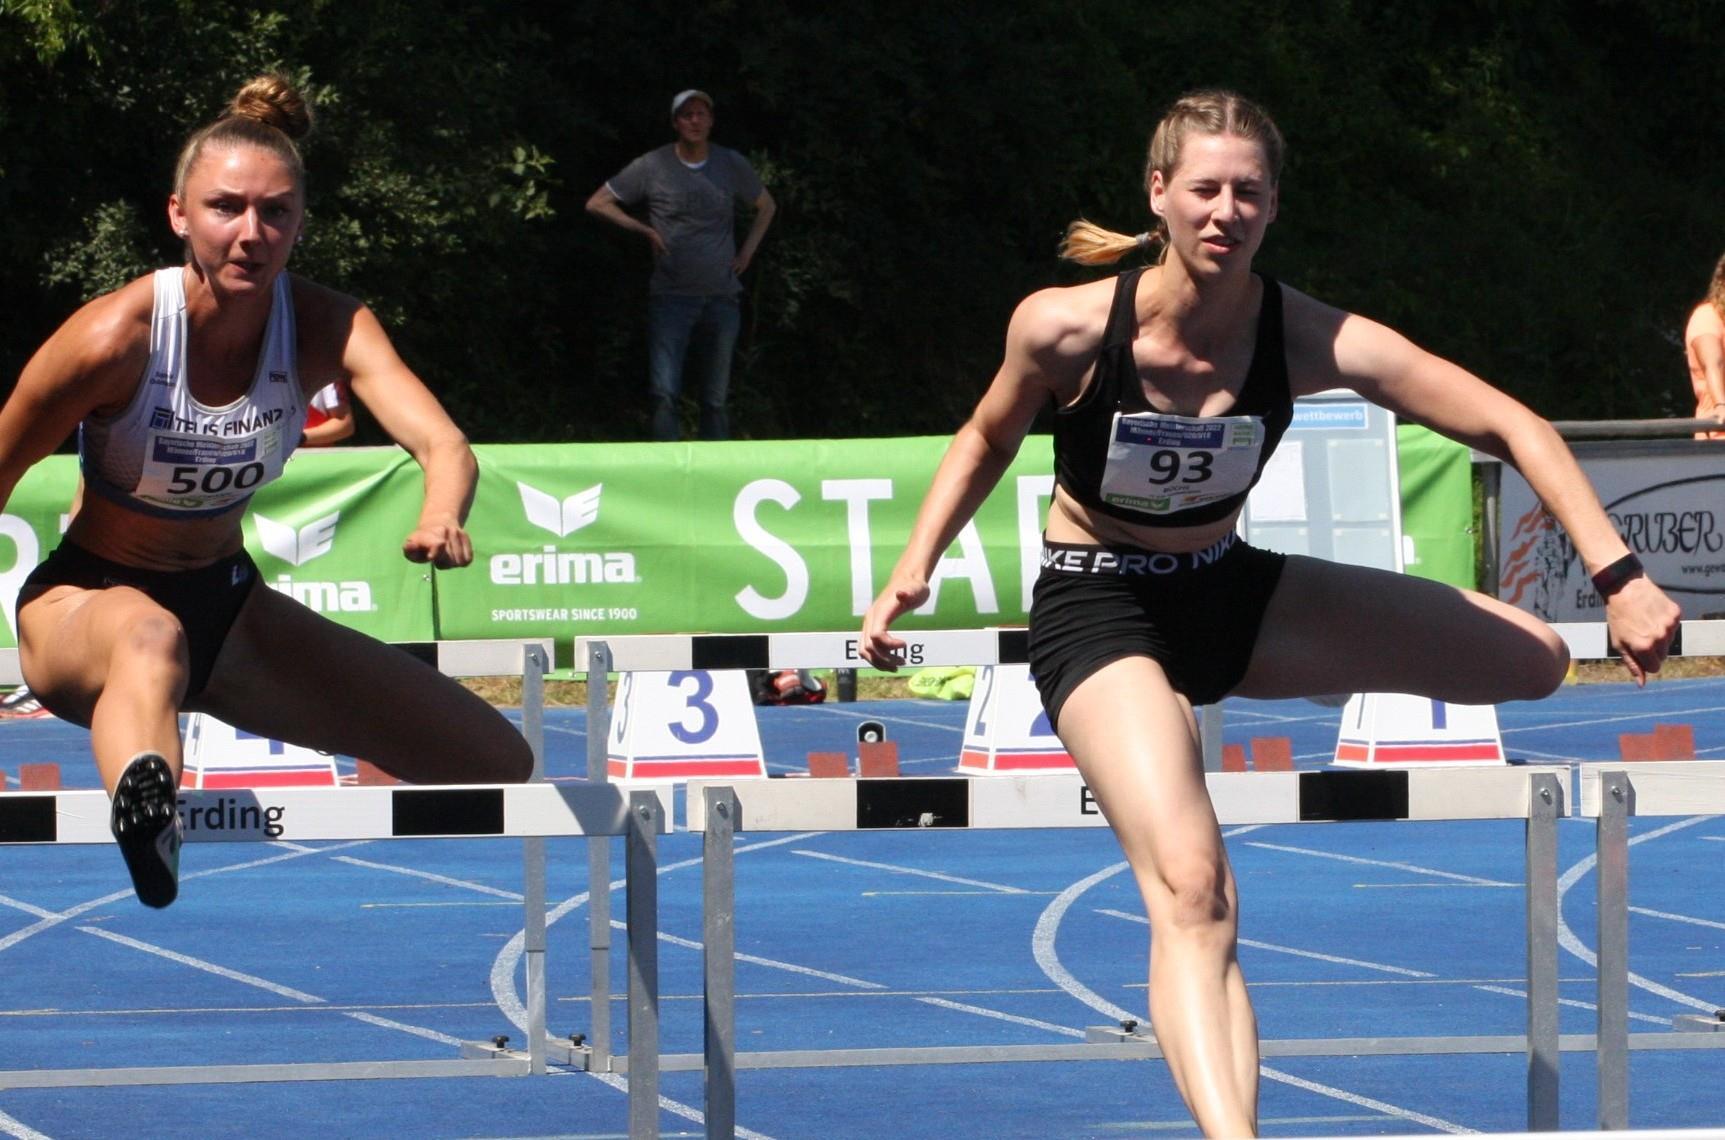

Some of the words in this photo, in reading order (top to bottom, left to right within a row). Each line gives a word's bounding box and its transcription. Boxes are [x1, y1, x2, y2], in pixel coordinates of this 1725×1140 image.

[167, 462, 265, 495] 500
[1148, 449, 1214, 485] 93
[1111, 496, 1149, 507] erima
[490, 545, 636, 585] erima
[1091, 552, 1178, 576] PRO
[491, 608, 569, 621] SPORTSWEAR
[571, 608, 605, 620] SINCE
[607, 607, 638, 620] 1900
[667, 669, 720, 745] 3
